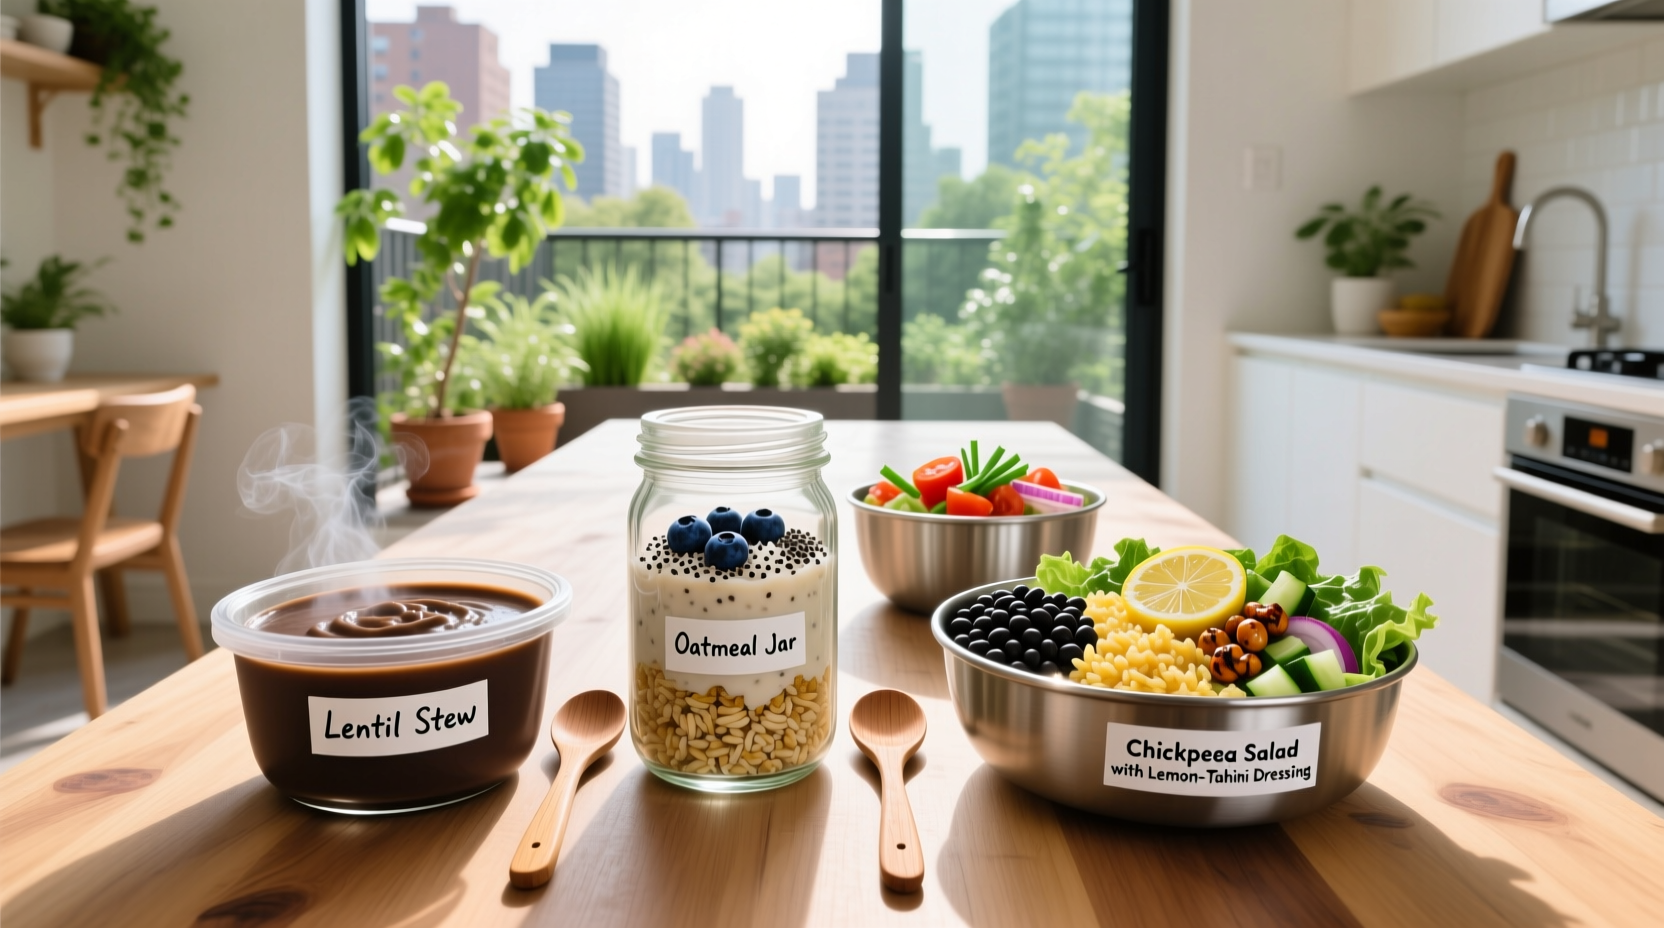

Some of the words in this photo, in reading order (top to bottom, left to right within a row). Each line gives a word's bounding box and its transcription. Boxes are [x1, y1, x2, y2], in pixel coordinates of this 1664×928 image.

[674, 631, 757, 657] Oatmeal
[764, 632, 798, 655] Jar
[324, 708, 401, 740] Lentil
[414, 704, 477, 735] Stew
[1126, 738, 1237, 768] Chickpeea
[1243, 738, 1299, 762] Salad
[1110, 763, 1144, 779] with
[1148, 765, 1249, 784] Lemon-Tahini
[1253, 765, 1311, 783] Dressing
